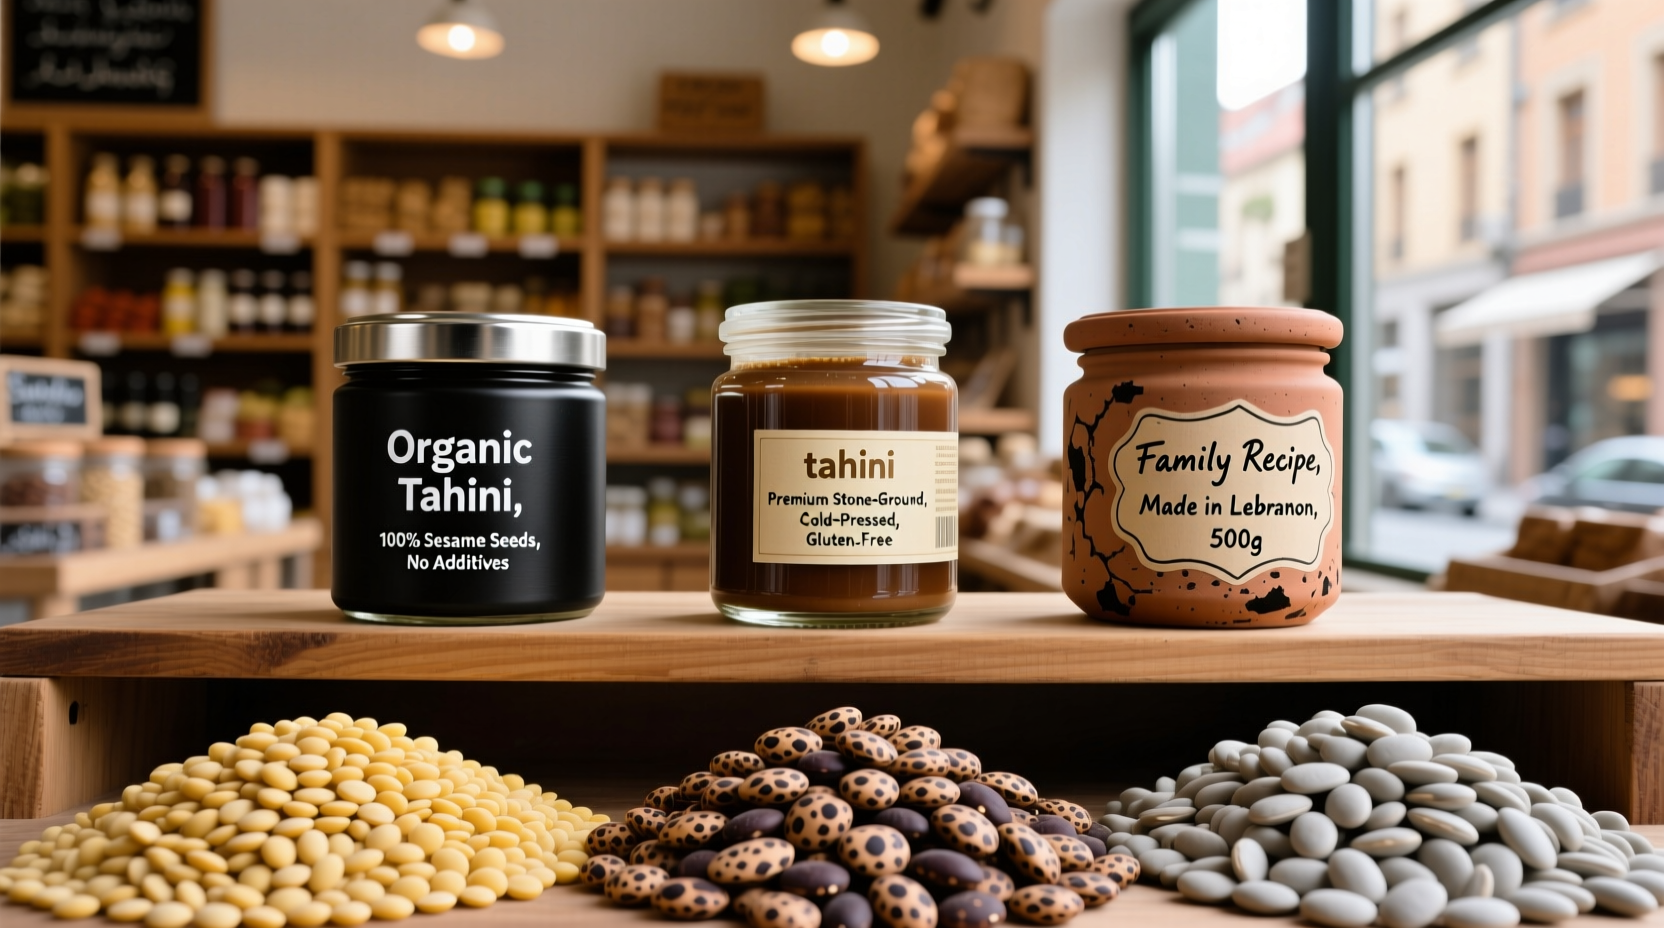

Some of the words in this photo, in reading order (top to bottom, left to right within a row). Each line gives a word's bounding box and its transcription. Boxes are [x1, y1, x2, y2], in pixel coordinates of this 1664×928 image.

[387, 429, 533, 473] Organic
[803, 448, 895, 480] tahini
[1135, 440, 1232, 487] Family
[1242, 438, 1322, 485] Recipe,
[397, 476, 523, 519] Tahini,
[767, 490, 829, 507] Premium
[832, 490, 928, 509] Stone-Ground,
[1138, 493, 1198, 517] Made
[1204, 495, 1222, 517] in
[1230, 493, 1319, 521] Lebranon,
[799, 511, 901, 531] Cold-Pressed,
[379, 531, 421, 549] 100%
[423, 531, 486, 549] Sesame
[489, 531, 542, 552] Seeds,
[805, 531, 894, 548] Gluten-Free
[1209, 527, 1263, 557] 500g
[407, 554, 430, 571] No
[432, 553, 510, 571] Additives
